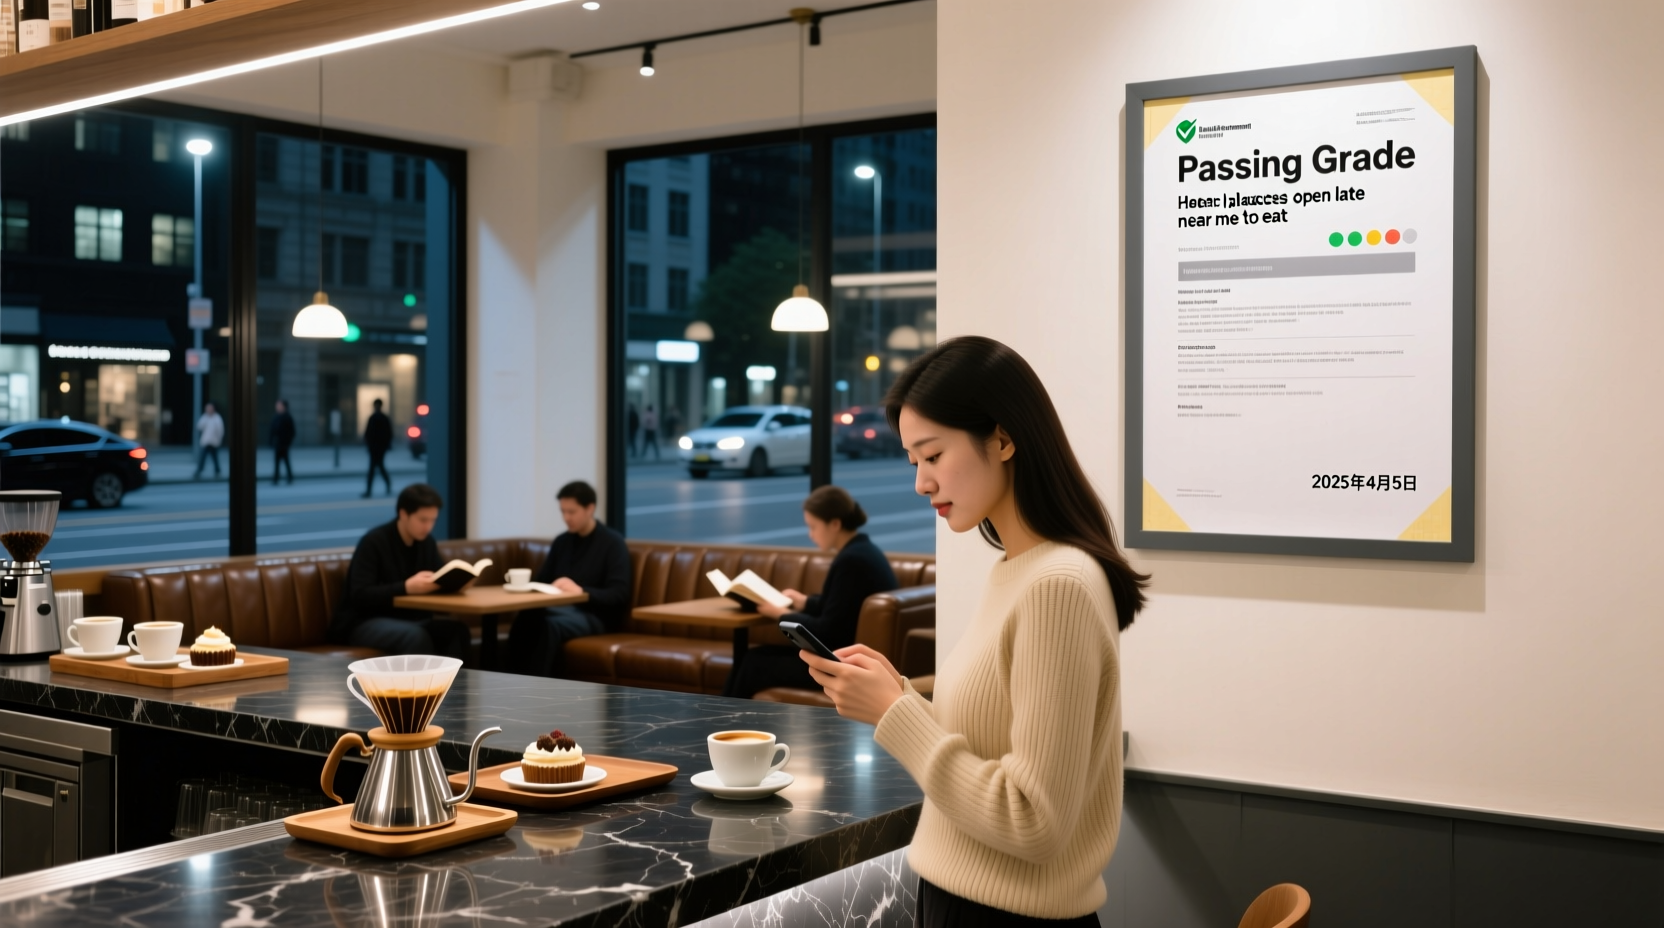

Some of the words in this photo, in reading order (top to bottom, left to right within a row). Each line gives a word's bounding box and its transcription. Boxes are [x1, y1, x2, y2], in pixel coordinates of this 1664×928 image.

[1178, 148, 1302, 184] Passing
[1312, 139, 1416, 174] Grade
[1292, 192, 1331, 207] open
[1335, 186, 1365, 202] late
[1178, 216, 1213, 229] near
[1215, 214, 1239, 226] me
[1242, 209, 1259, 224] to
[1262, 208, 1288, 224] eat
[1311, 473, 1417, 492] 2025年4月5日
